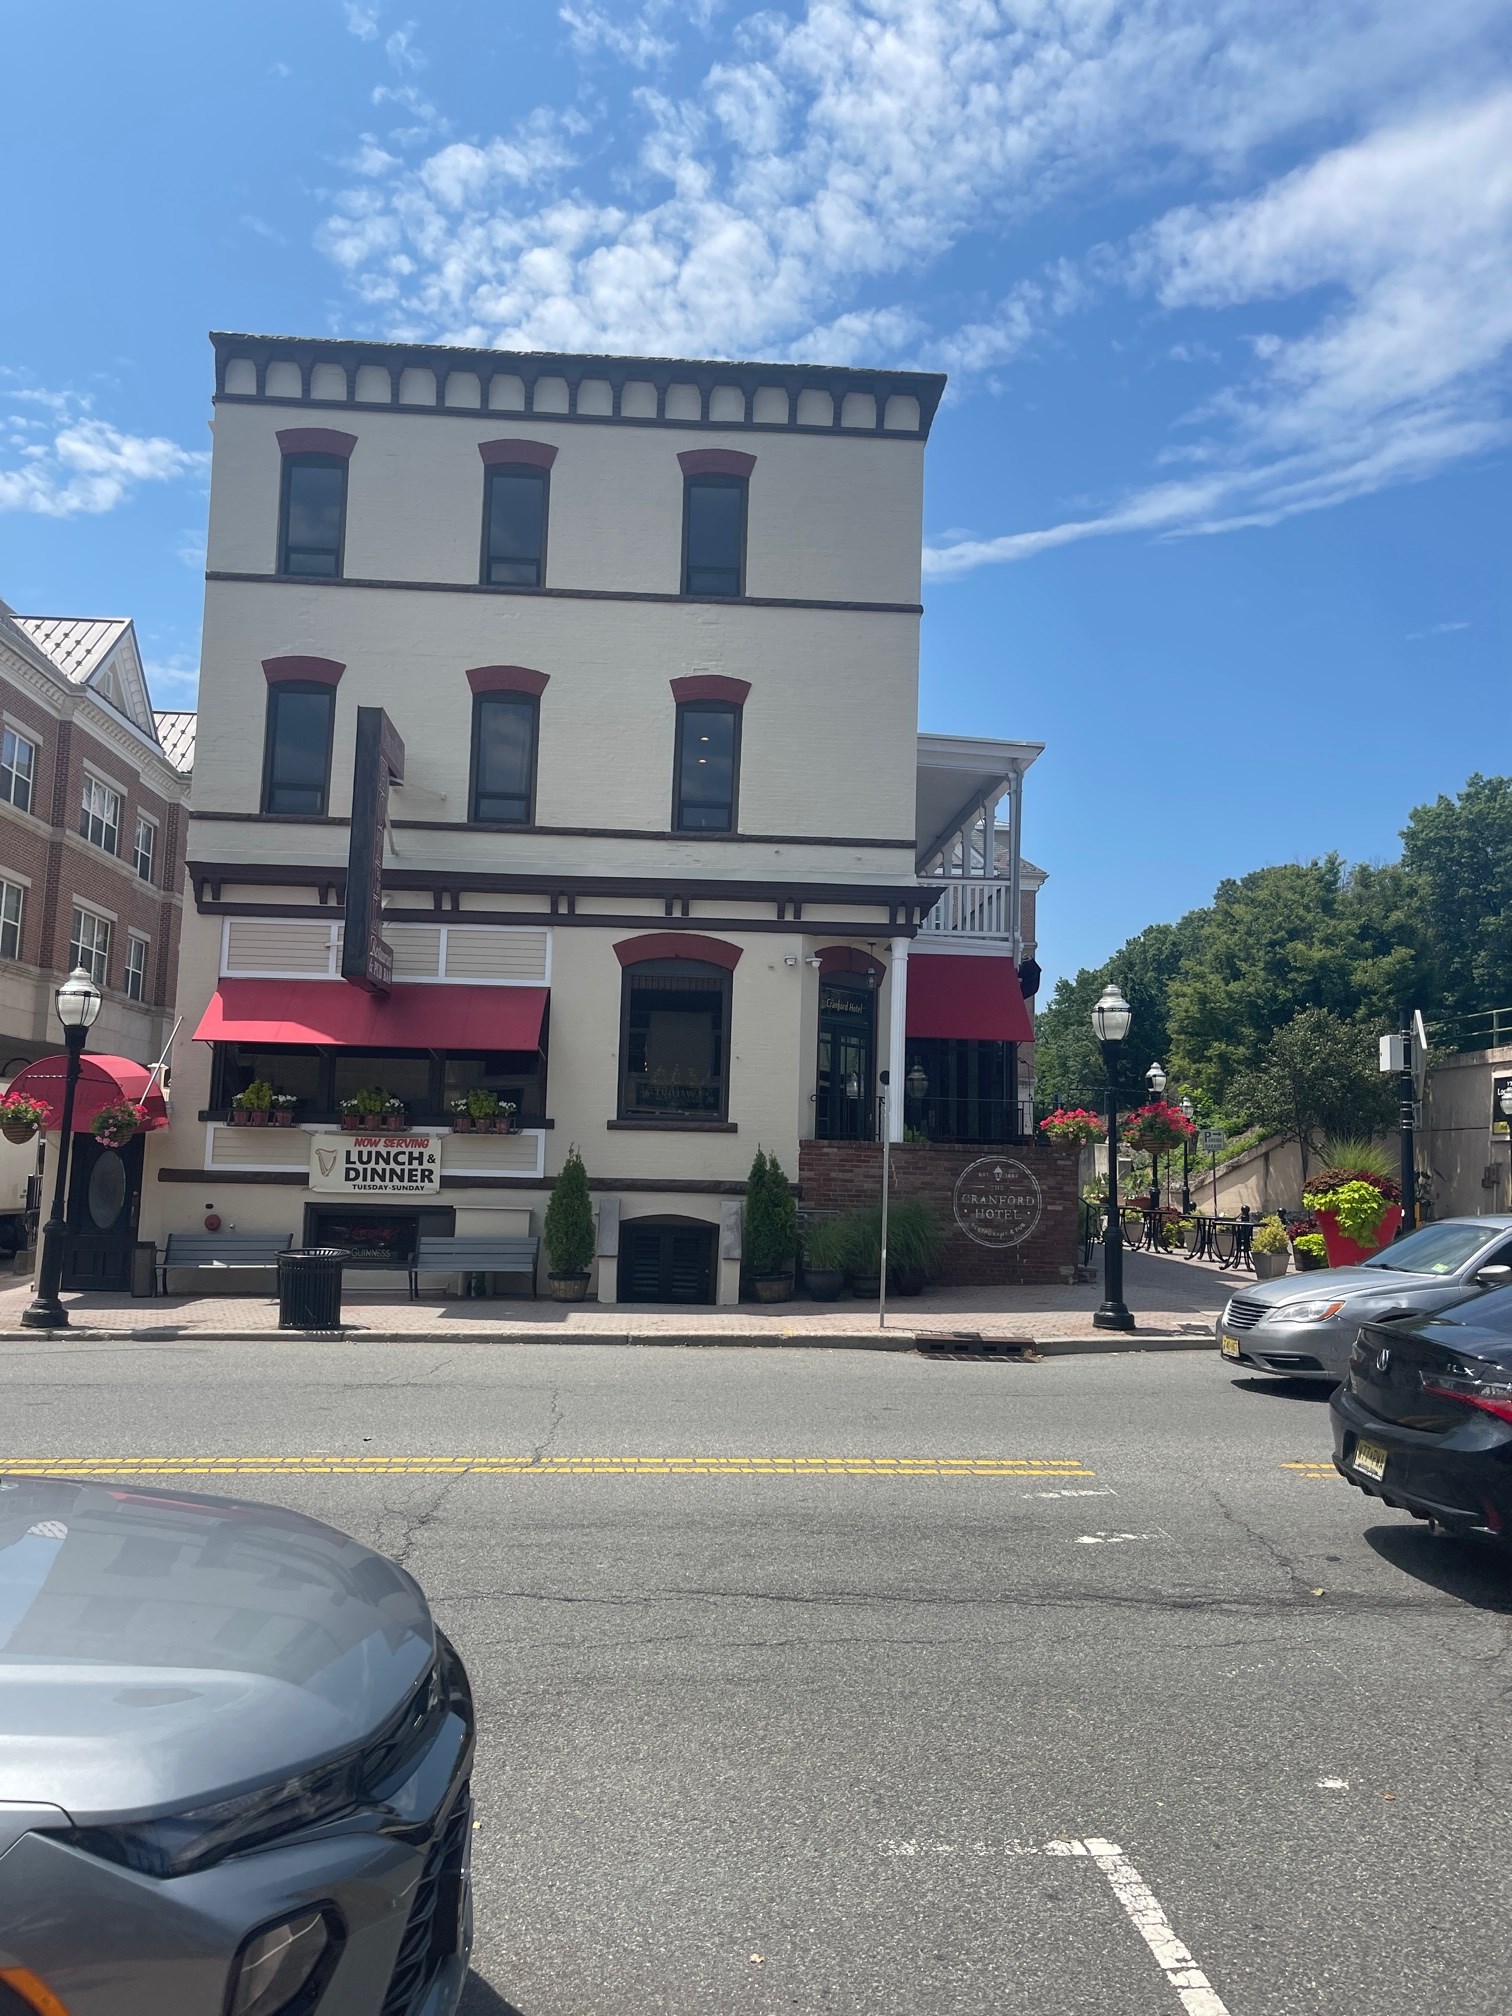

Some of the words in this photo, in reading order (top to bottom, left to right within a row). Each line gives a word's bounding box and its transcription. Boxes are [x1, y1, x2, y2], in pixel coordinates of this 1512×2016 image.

[826, 997, 849, 1012] Cranford
[849, 1002, 863, 1014] Hotel
[354, 1138, 381, 1148] NOW
[383, 1138, 429, 1149] SERVING
[345, 1150, 424, 1166] LUNCH
[427, 1153, 436, 1164] &
[345, 1167, 434, 1183] DINNER
[962, 1194, 1035, 1206] CRANFORD
[975, 1208, 1022, 1220] HOTEL
[971, 1222, 1007, 1236] RESTAURANT
[1014, 1222, 1026, 1232] PUB
[351, 1247, 391, 1258] GUINNESS
